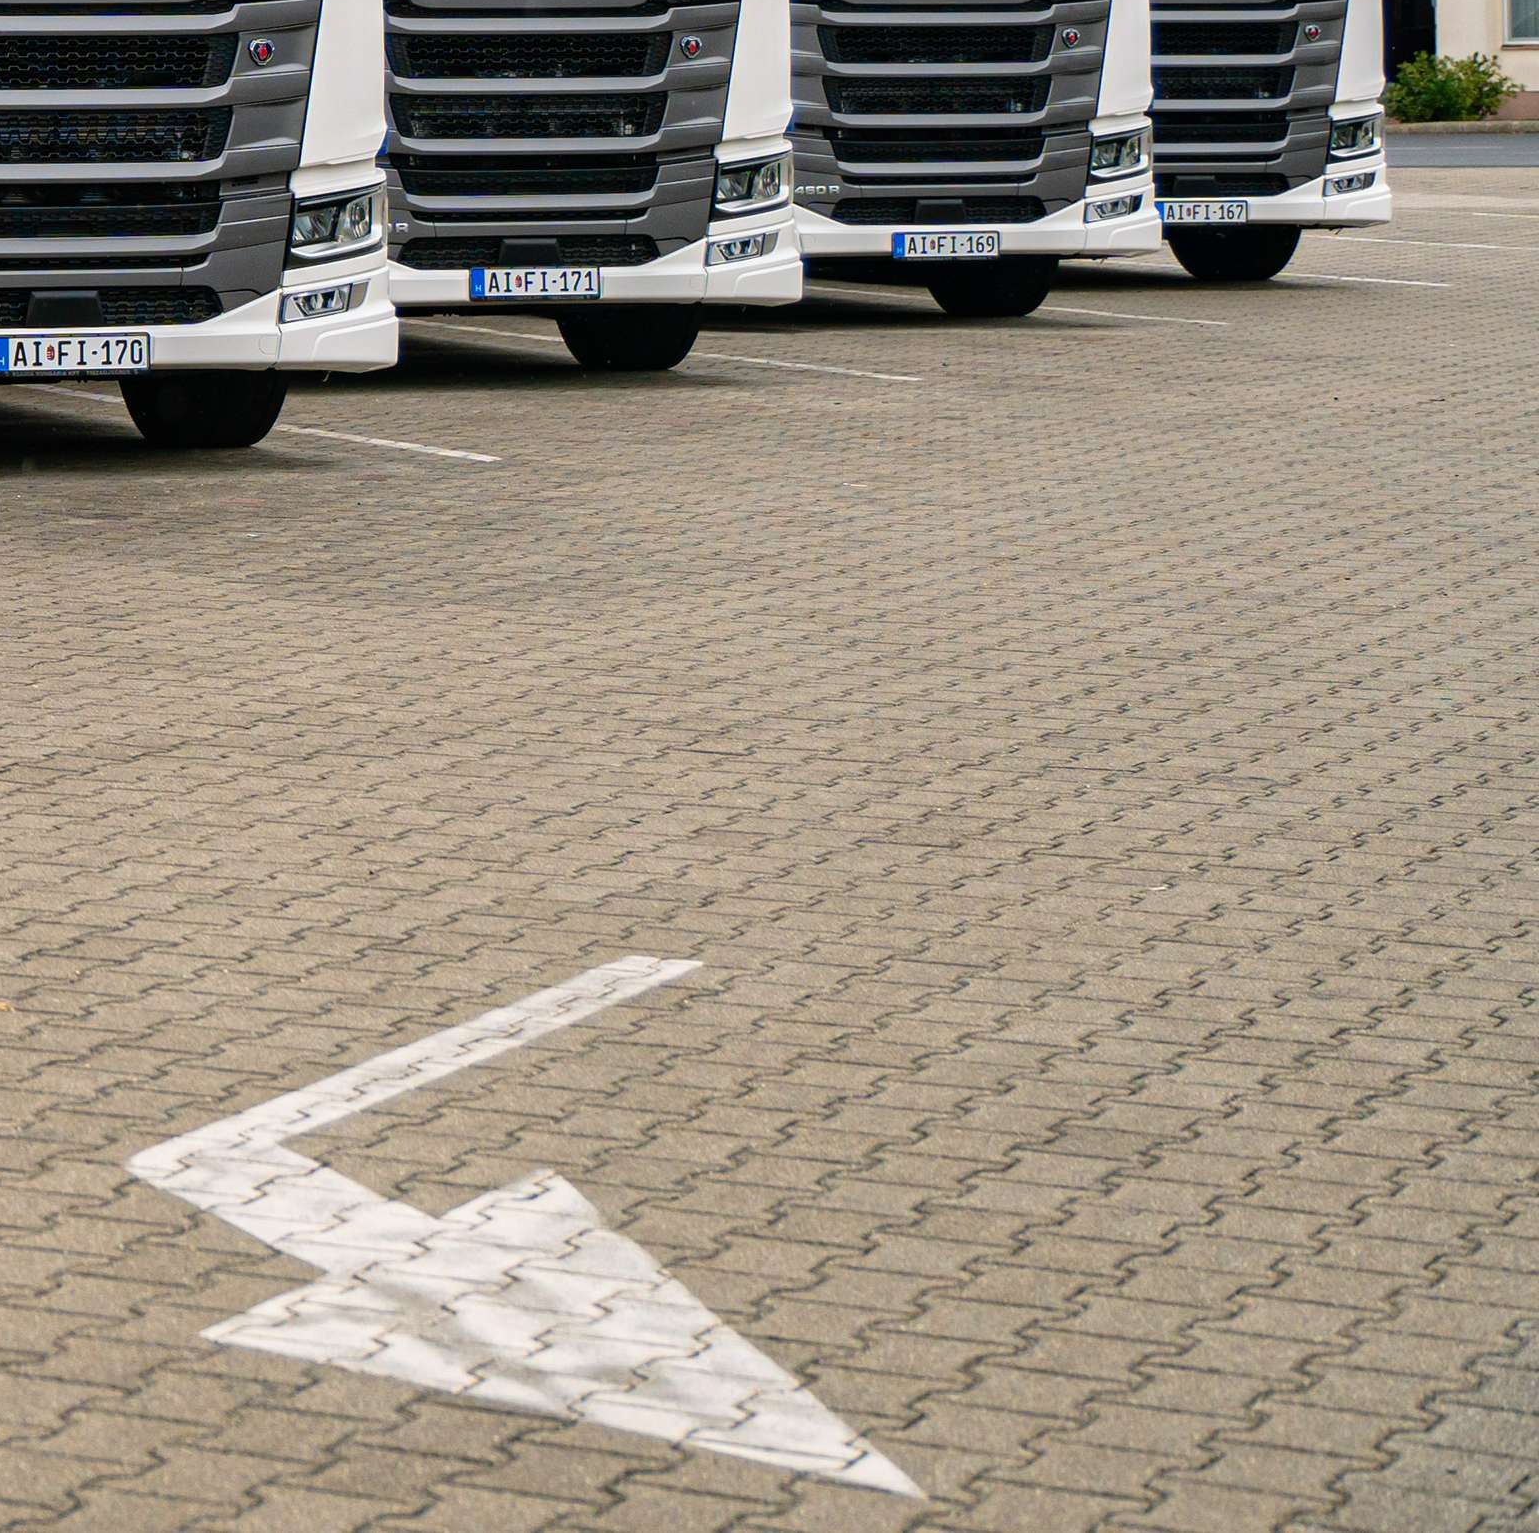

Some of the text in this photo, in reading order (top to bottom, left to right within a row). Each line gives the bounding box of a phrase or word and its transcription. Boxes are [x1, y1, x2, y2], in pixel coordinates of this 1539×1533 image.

[828, 185, 840, 195] R
[1166, 204, 1243, 220] AI FI-167
[907, 235, 995, 254] AI FI-169
[488, 271, 595, 292] AI FI-171
[13, 340, 143, 367] AI FI-170
